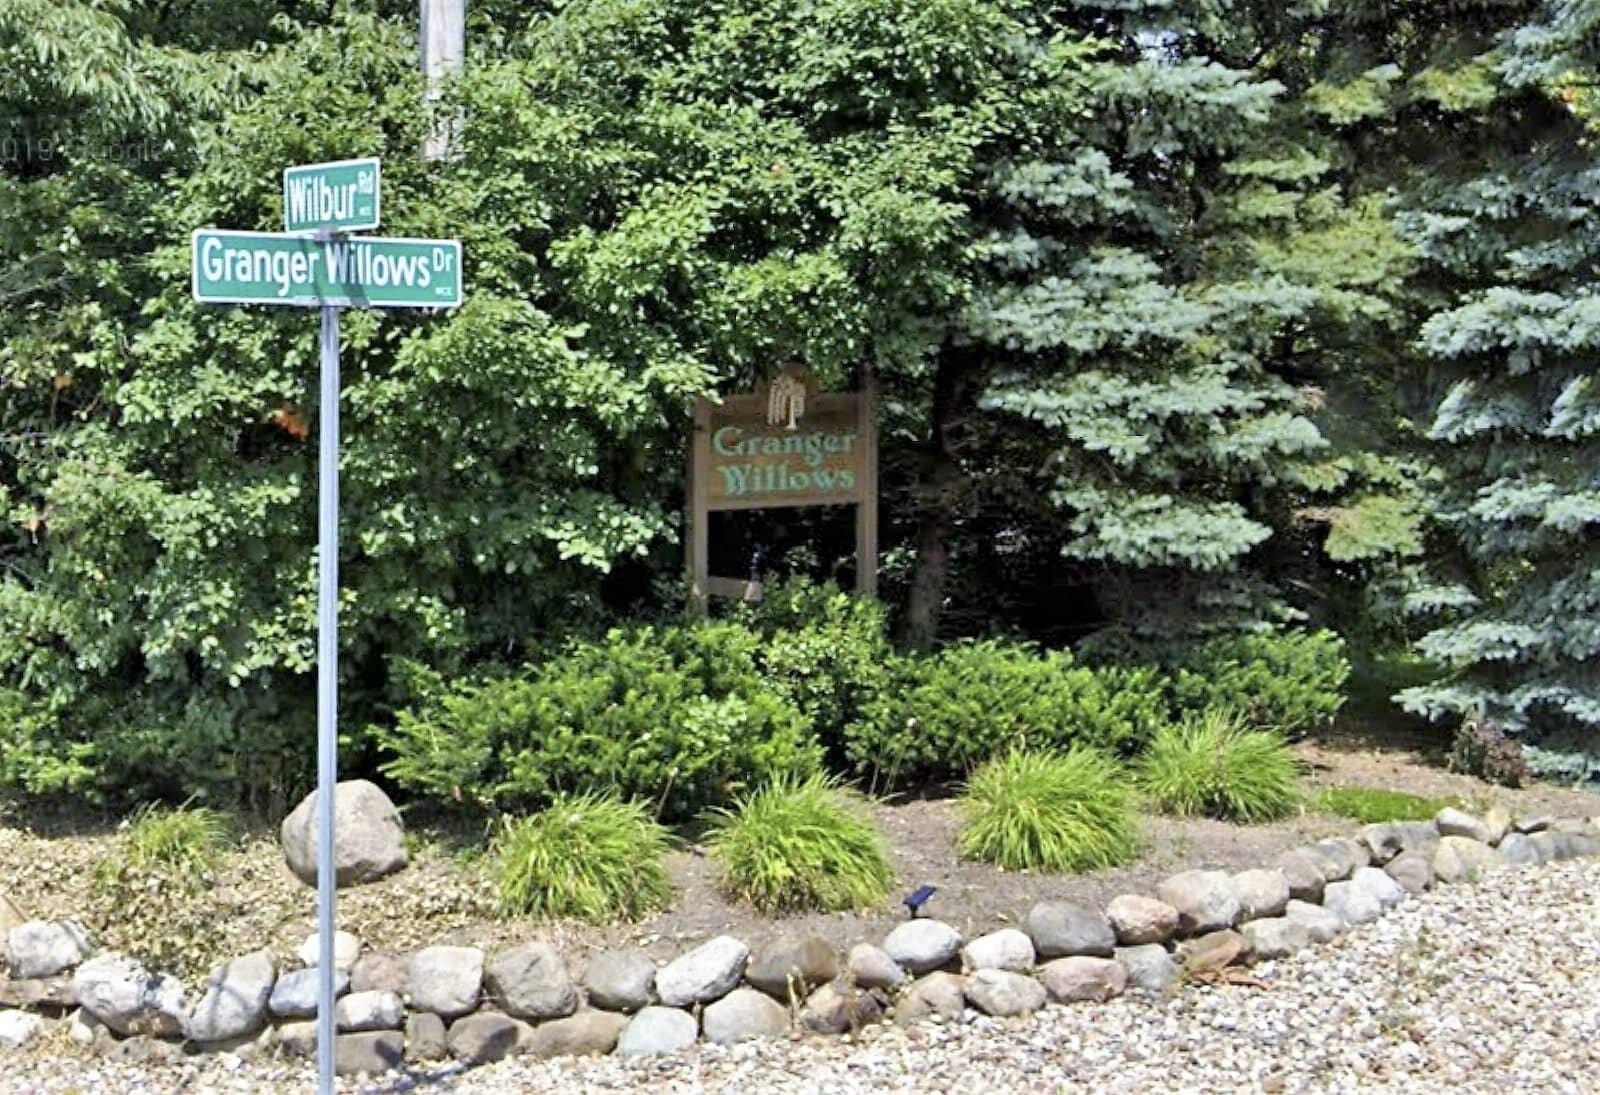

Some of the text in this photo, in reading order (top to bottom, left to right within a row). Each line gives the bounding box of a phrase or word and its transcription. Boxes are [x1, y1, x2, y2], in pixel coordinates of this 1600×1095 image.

[289, 170, 373, 223] Wilbur Rd
[202, 237, 454, 296] Granger Willows Dr
[713, 426, 857, 466] Granger
[718, 462, 855, 495] Willows
